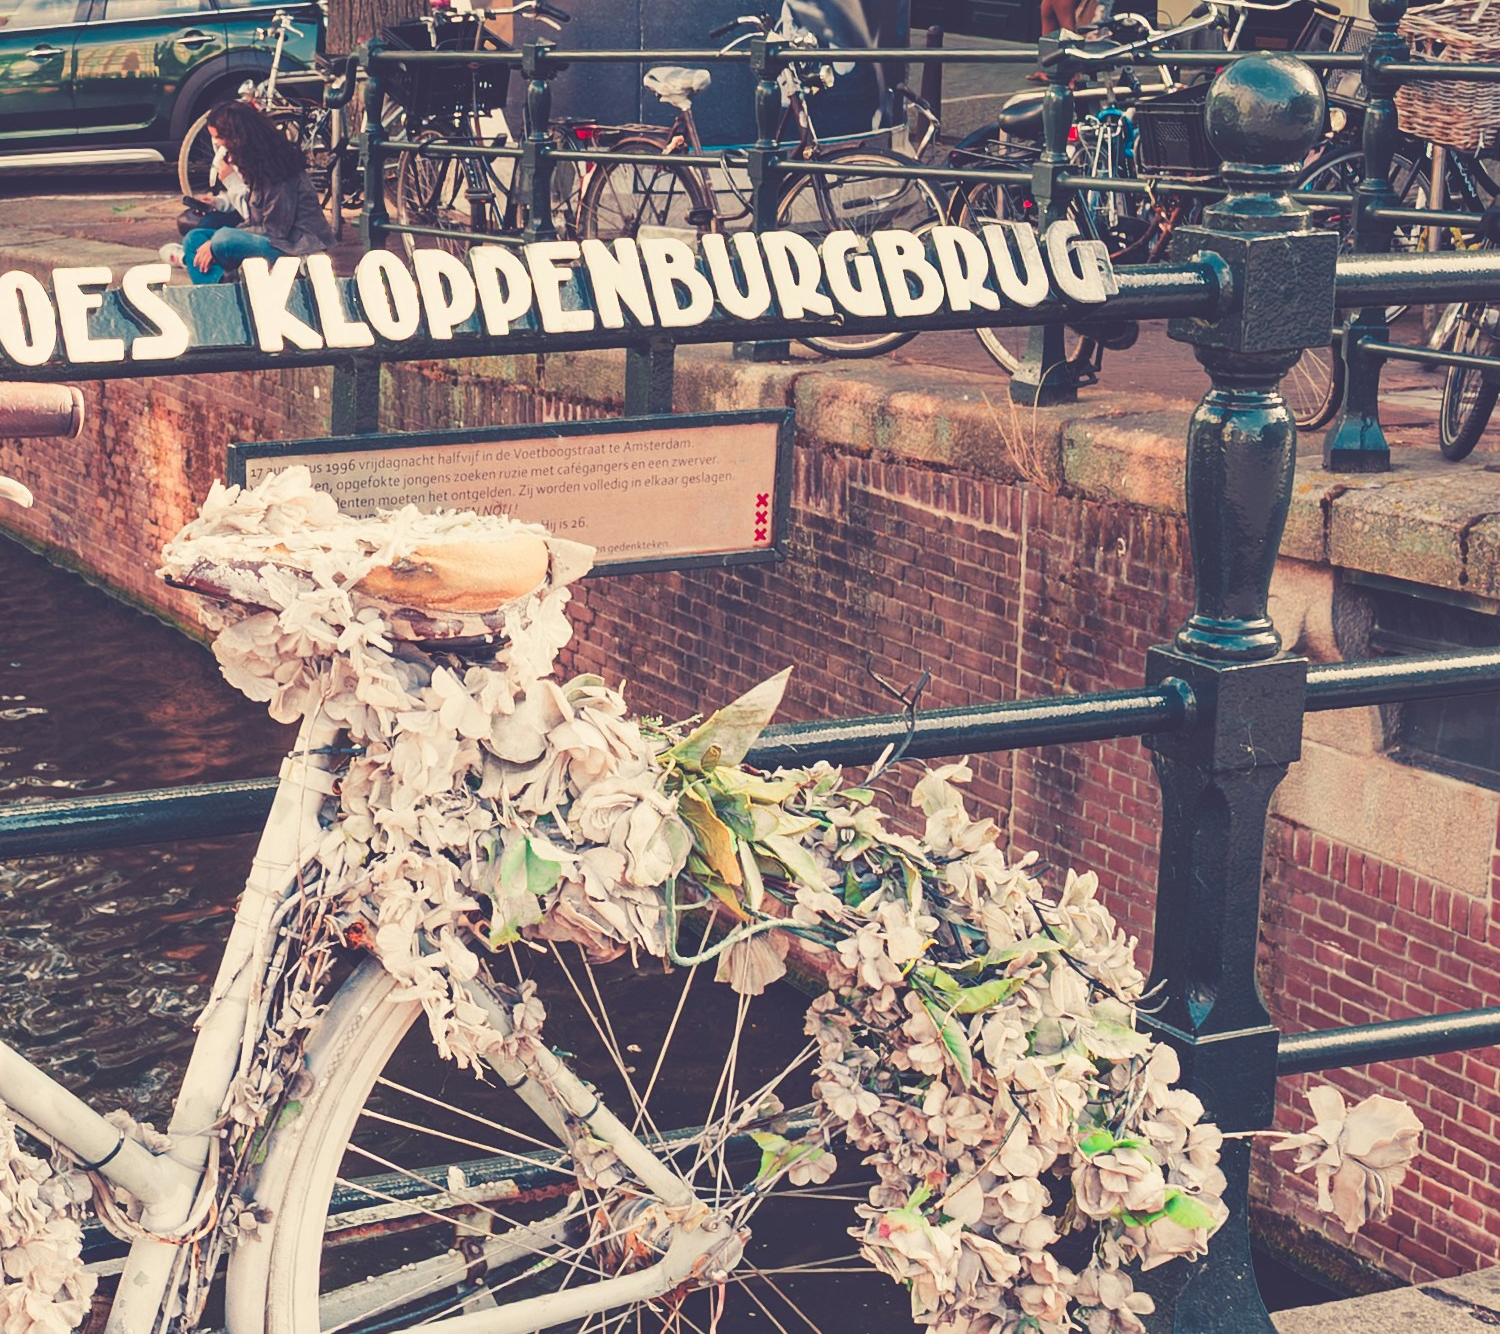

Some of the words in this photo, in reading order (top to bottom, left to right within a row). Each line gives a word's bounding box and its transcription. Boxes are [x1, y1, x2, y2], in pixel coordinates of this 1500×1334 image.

[242, 220, 1112, 353] KLOPPENBURGBRUG
[250, 467, 263, 480] 17
[325, 458, 356, 475] 1996
[358, 454, 434, 473] vrijdagnacht
[437, 451, 481, 467] halfvijf
[482, 450, 494, 462] in
[495, 449, 512, 461] de
[514, 444, 606, 460] Voetboogstraat
[608, 443, 621, 454] te
[623, 438, 695, 453] Amsterdam.
[336, 475, 401, 493] opgefokte
[402, 473, 451, 489] jongens
[453, 468, 496, 483] zoeken
[499, 466, 528, 480] ruzie
[530, 465, 554, 477] met
[557, 461, 629, 477] cafégangers
[631, 460, 646, 470] en
[648, 458, 669, 469] een
[671, 455, 720, 467] zwerver.
[378, 493, 425, 506] moeten
[428, 490, 448, 503] het
[451, 486, 516, 502] ontgelden.
[518, 484, 534, 499] Zij
[536, 481, 580, 495] worden
[583, 477, 629, 491] volledig
[631, 478, 642, 488] in
[644, 474, 680, 487] elkaar
[681, 471, 736, 488] geslagen.
[540, 518, 557, 533] Hij
[559, 518, 569, 529] is
[571, 515, 589, 529] 26.
[607, 540, 672, 555] gedenkteken.
